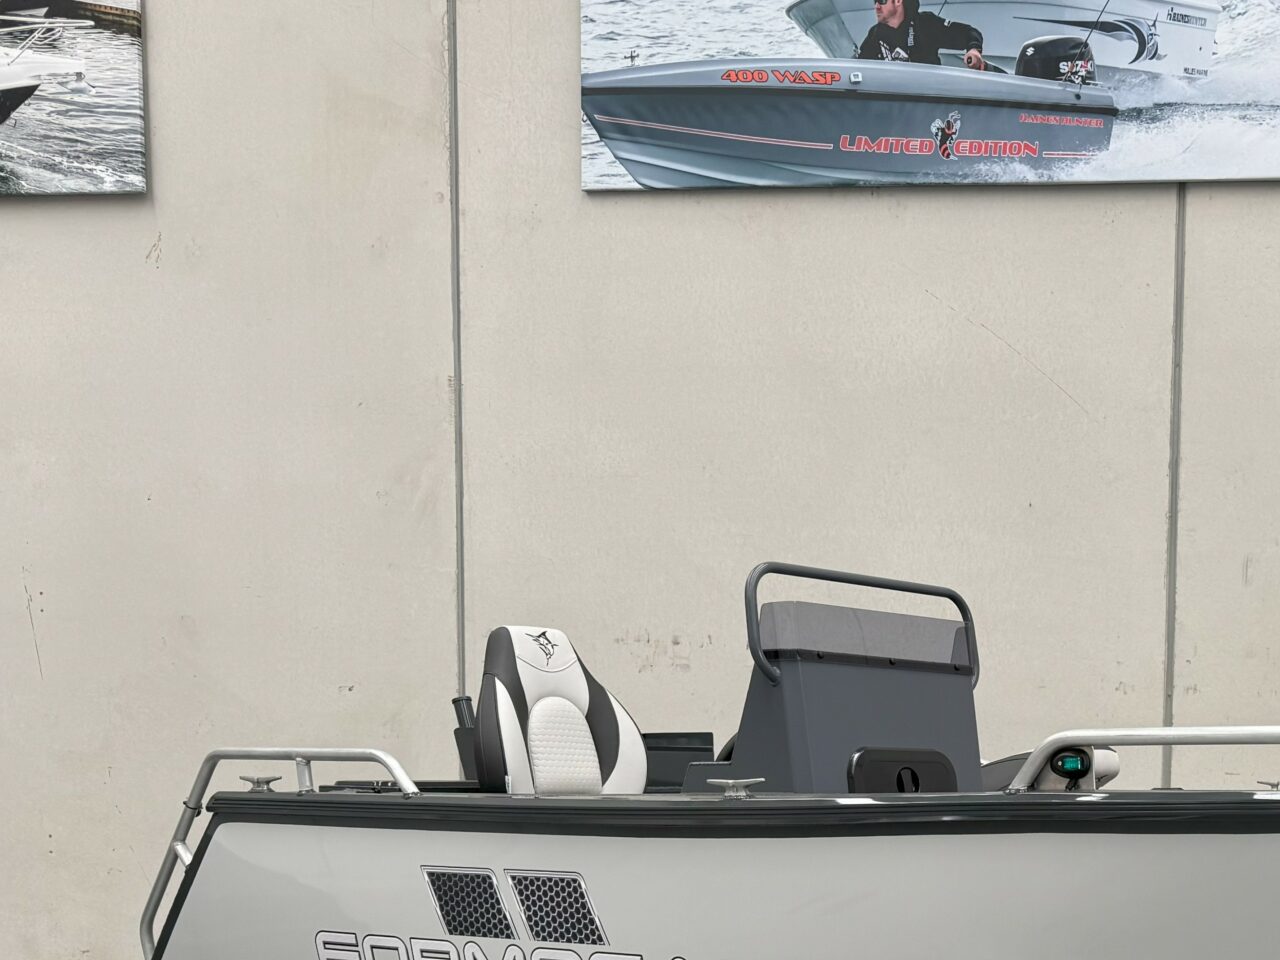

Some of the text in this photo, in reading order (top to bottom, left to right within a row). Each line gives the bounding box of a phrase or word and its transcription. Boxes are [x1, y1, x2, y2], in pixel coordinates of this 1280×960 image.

[721, 69, 841, 85] 400 WASP
[840, 135, 1039, 157] LIMITED EDITION
